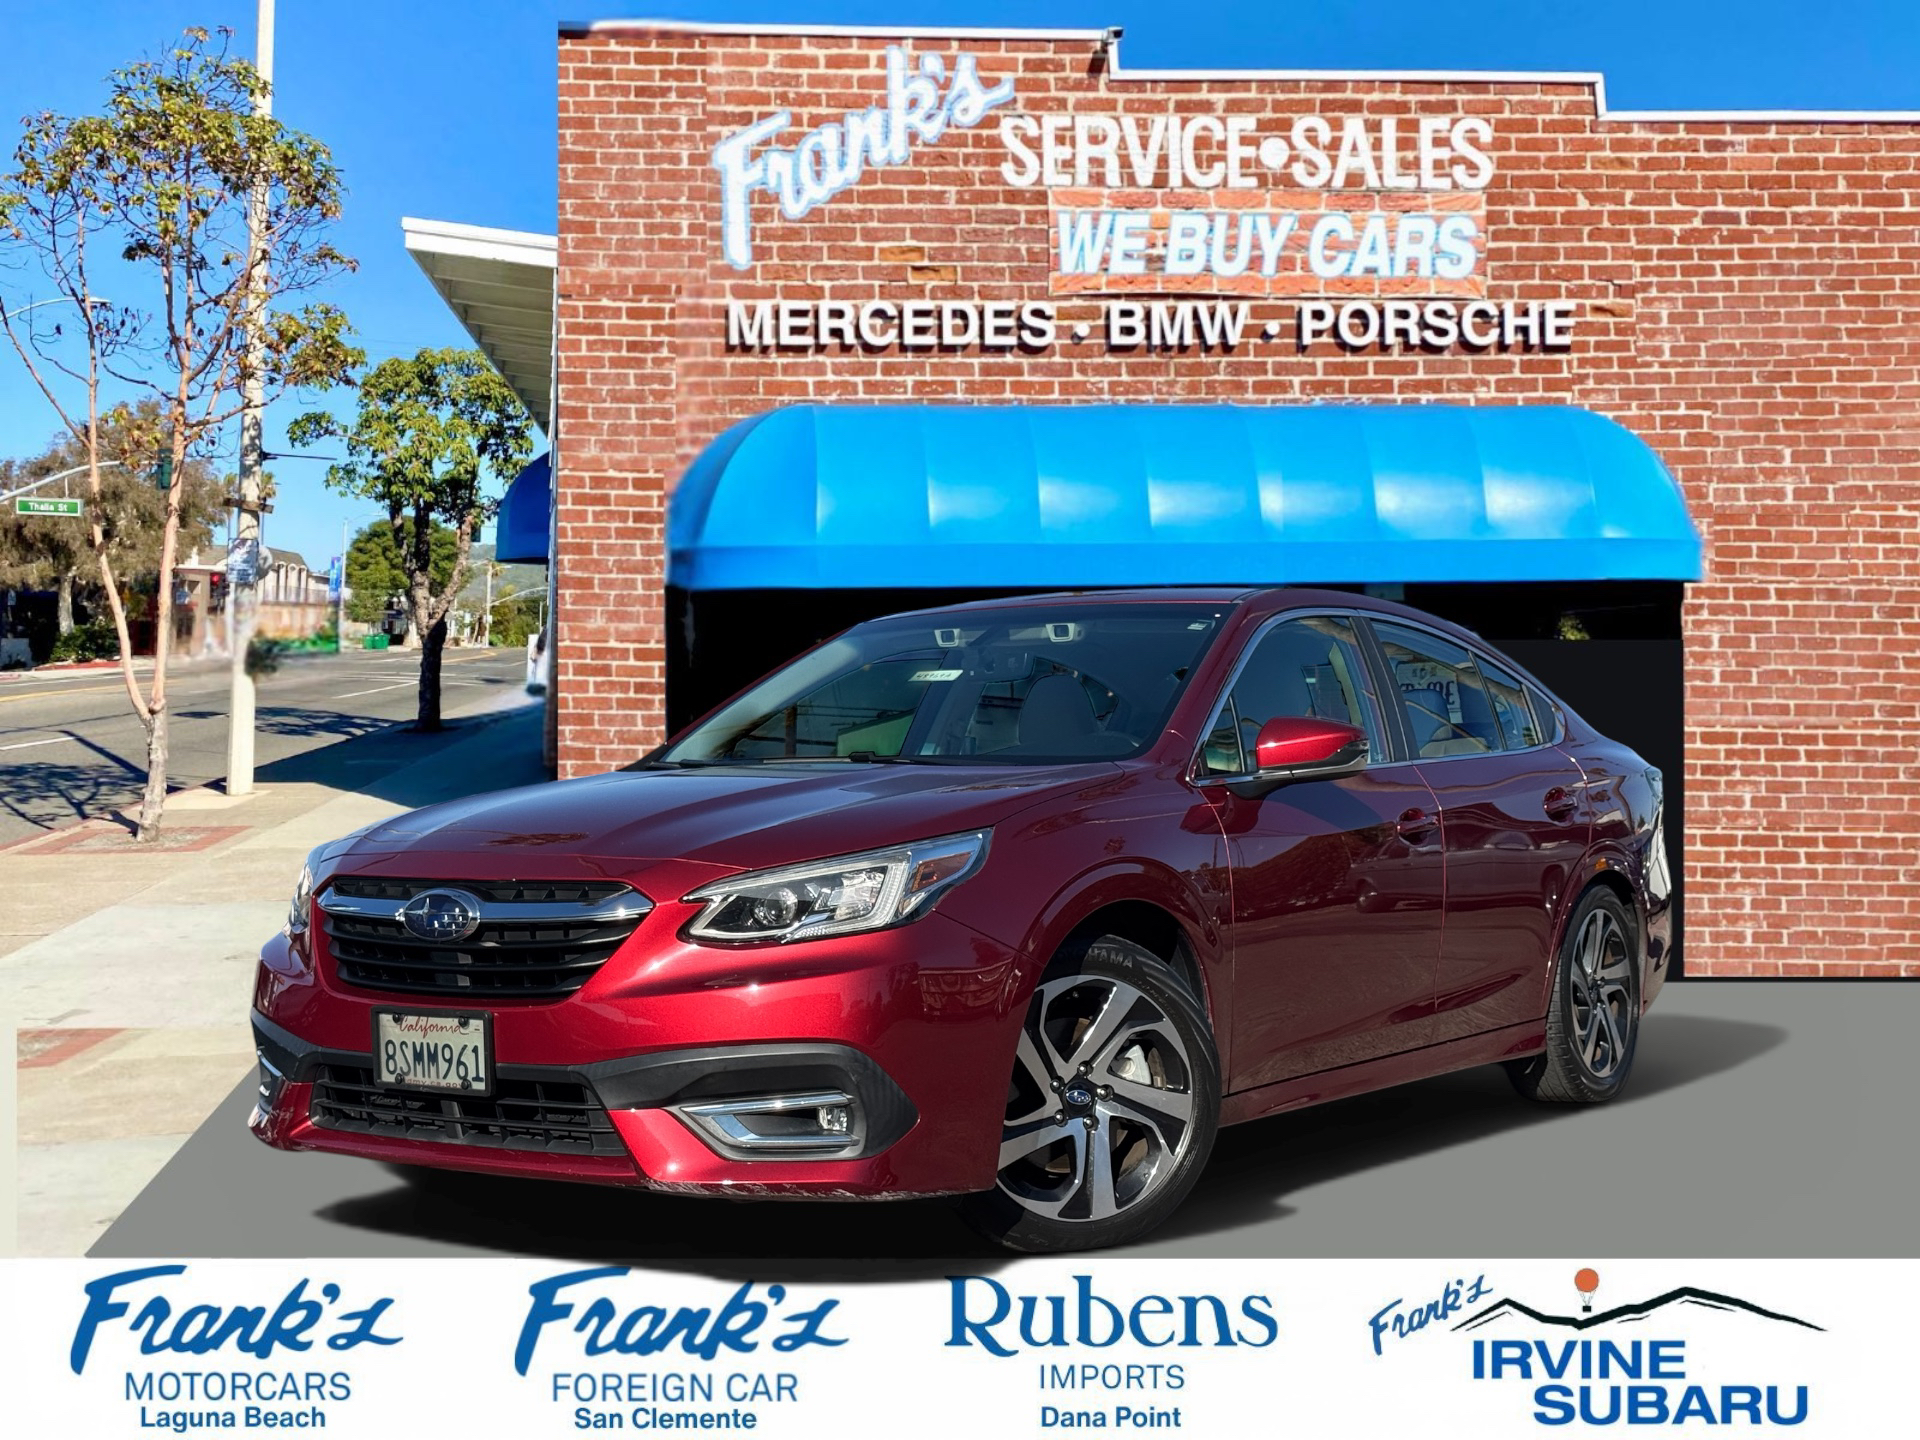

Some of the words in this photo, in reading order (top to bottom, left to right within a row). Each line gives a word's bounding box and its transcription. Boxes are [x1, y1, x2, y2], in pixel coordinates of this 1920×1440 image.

[713, 44, 1015, 270] Frank's
[1056, 210, 1151, 275] WE
[1163, 210, 1297, 278] BUY
[1308, 212, 1478, 280] CARS
[726, 300, 1057, 350] MERCEDES
[1106, 302, 1250, 350] BMW
[1297, 302, 1576, 350] PORSCHE
[399, 1016, 470, 1039] California
[385, 1039, 485, 1083] 8SMM961
